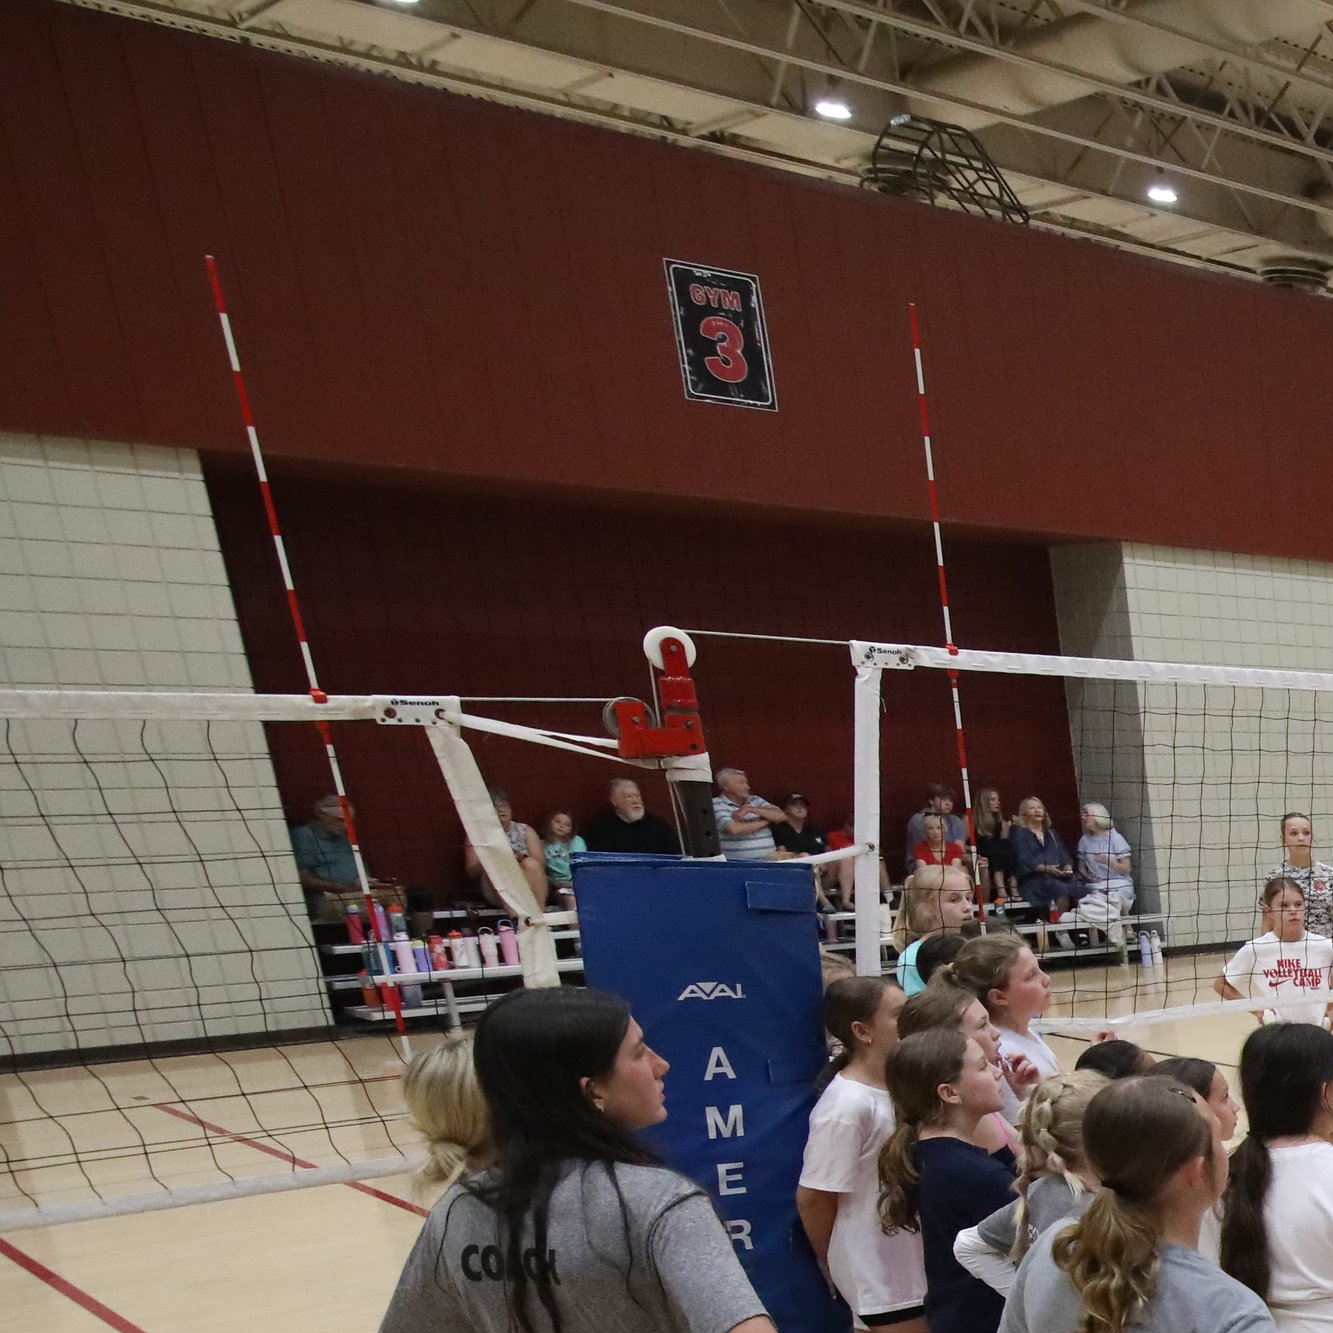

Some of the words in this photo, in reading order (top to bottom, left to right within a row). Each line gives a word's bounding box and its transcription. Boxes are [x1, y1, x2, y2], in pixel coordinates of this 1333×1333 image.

[689, 283, 742, 312] GYM
[700, 316, 748, 383] 3
[1277, 959, 1301, 968] NIKE
[1263, 968, 1322, 979] VOLLEYBALL
[1293, 977, 1321, 987] CAMP
